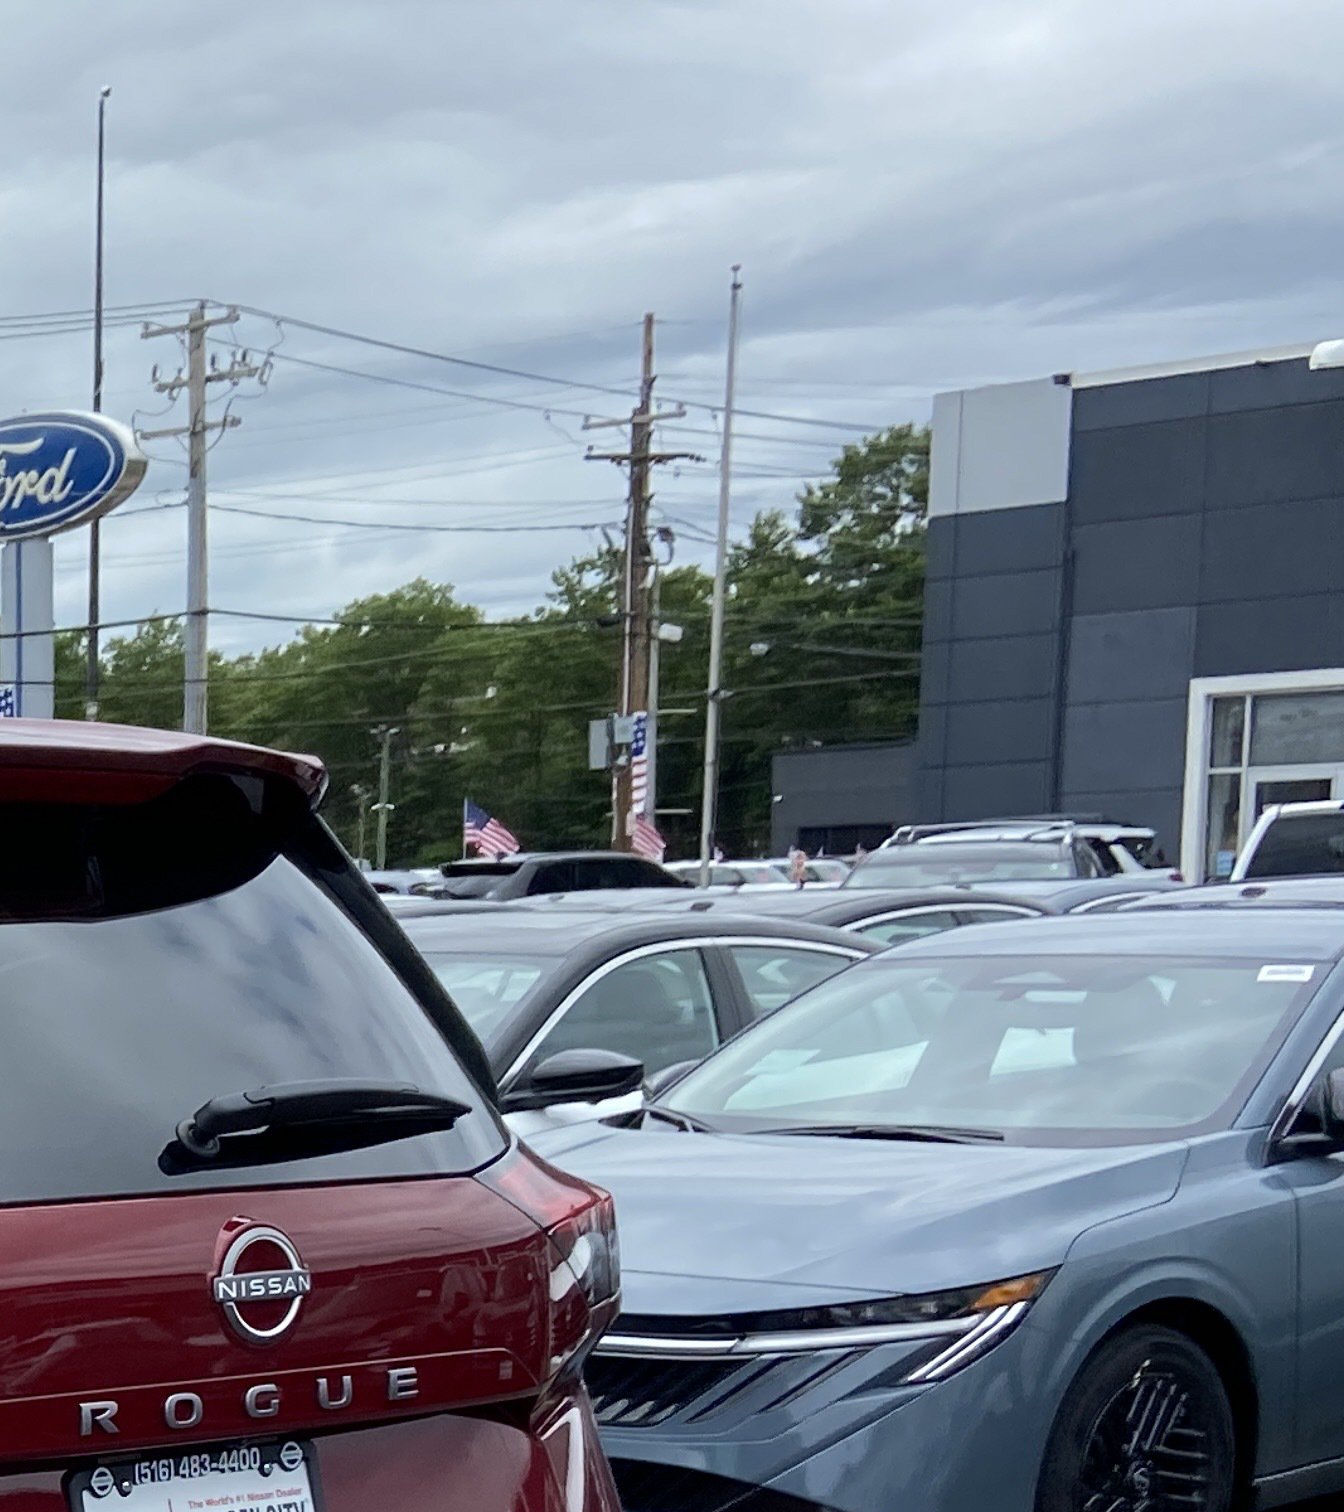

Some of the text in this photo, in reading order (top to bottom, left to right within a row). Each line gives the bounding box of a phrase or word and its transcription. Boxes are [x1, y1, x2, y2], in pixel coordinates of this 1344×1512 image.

[217, 1275, 310, 1299] NISSAN
[79, 1366, 419, 1437] ROGUE
[134, 1447, 261, 1485] (516) 483-4400
[188, 1500, 203, 1509] The
[275, 1487, 303, 1498] Dealer
